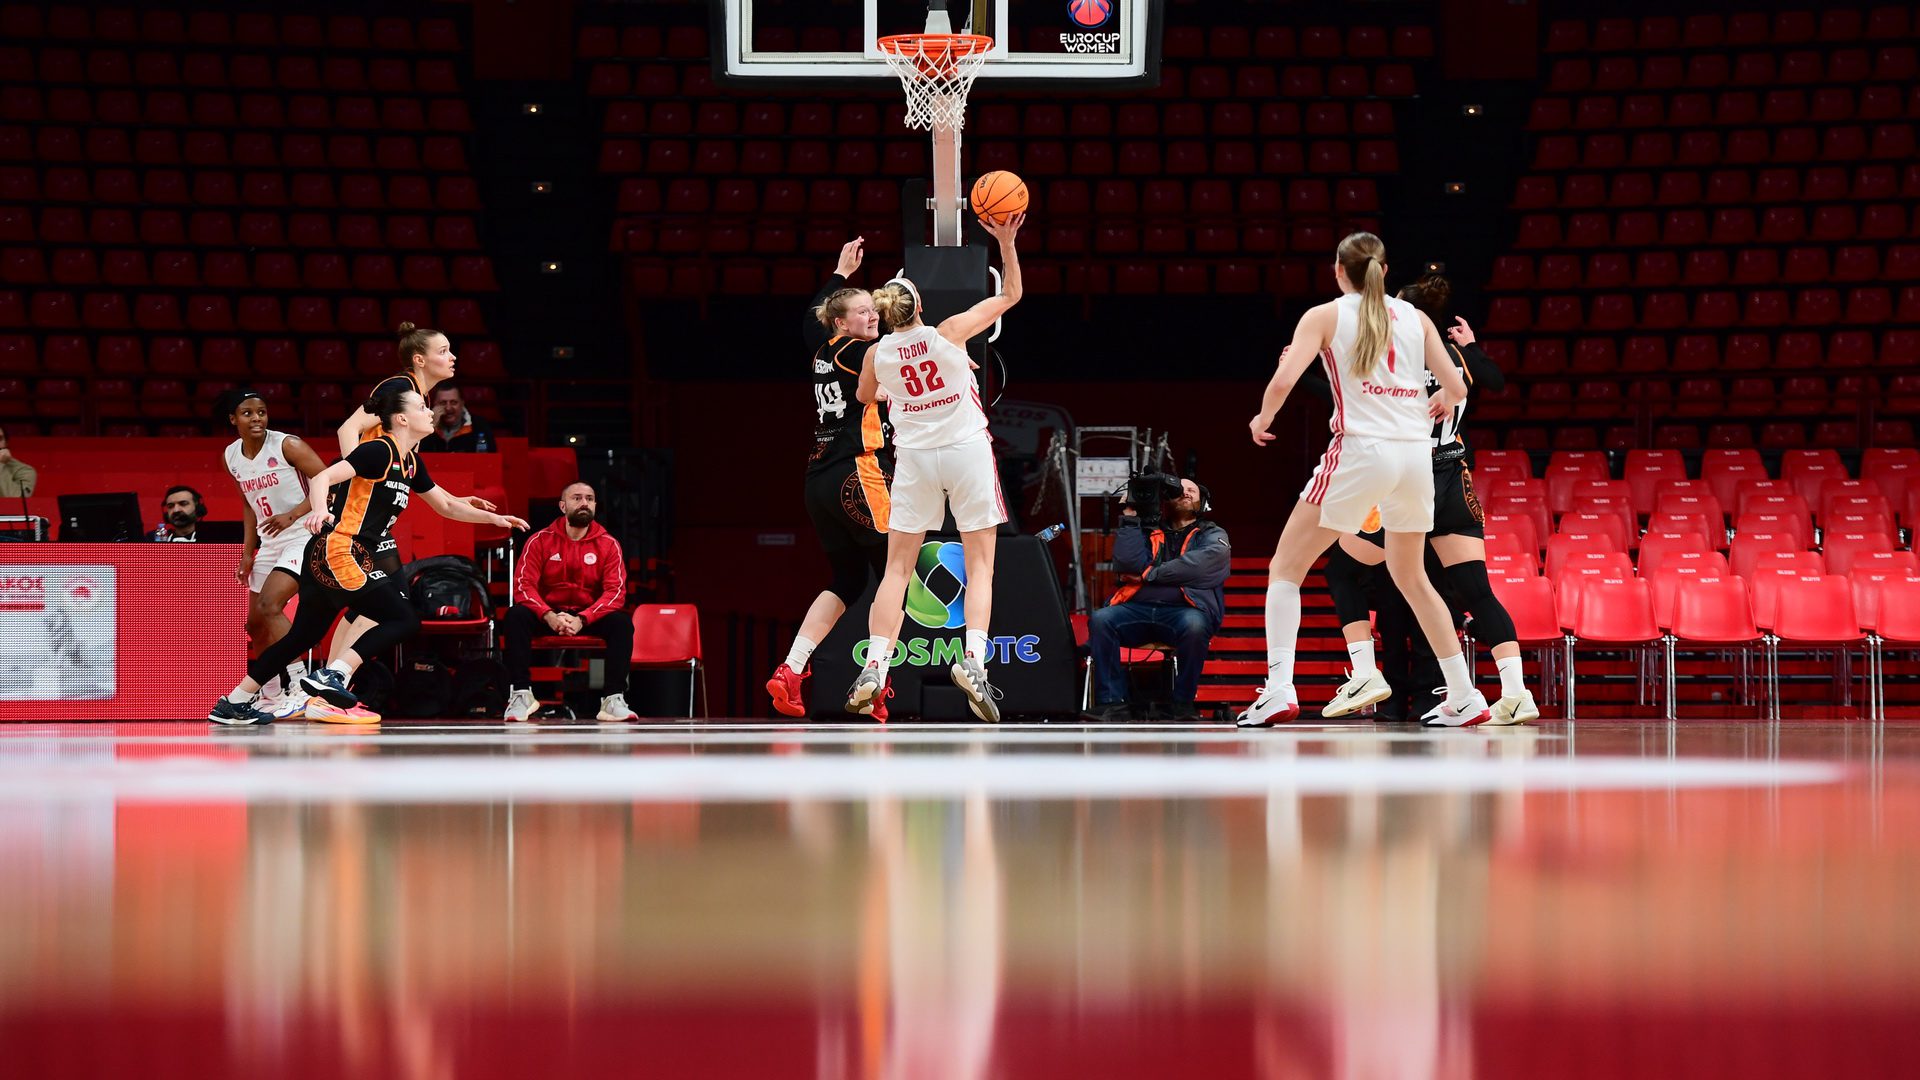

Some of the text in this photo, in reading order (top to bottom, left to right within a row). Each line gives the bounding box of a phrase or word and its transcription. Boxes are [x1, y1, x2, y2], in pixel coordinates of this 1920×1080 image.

[1060, 33, 1120, 43] EUROCUP
[1064, 43, 1115, 53] WOMEN
[897, 341, 928, 360] TOBIN
[900, 360, 945, 397] 32
[903, 393, 960, 412] Stoiximan
[256, 497, 273, 517] 15
